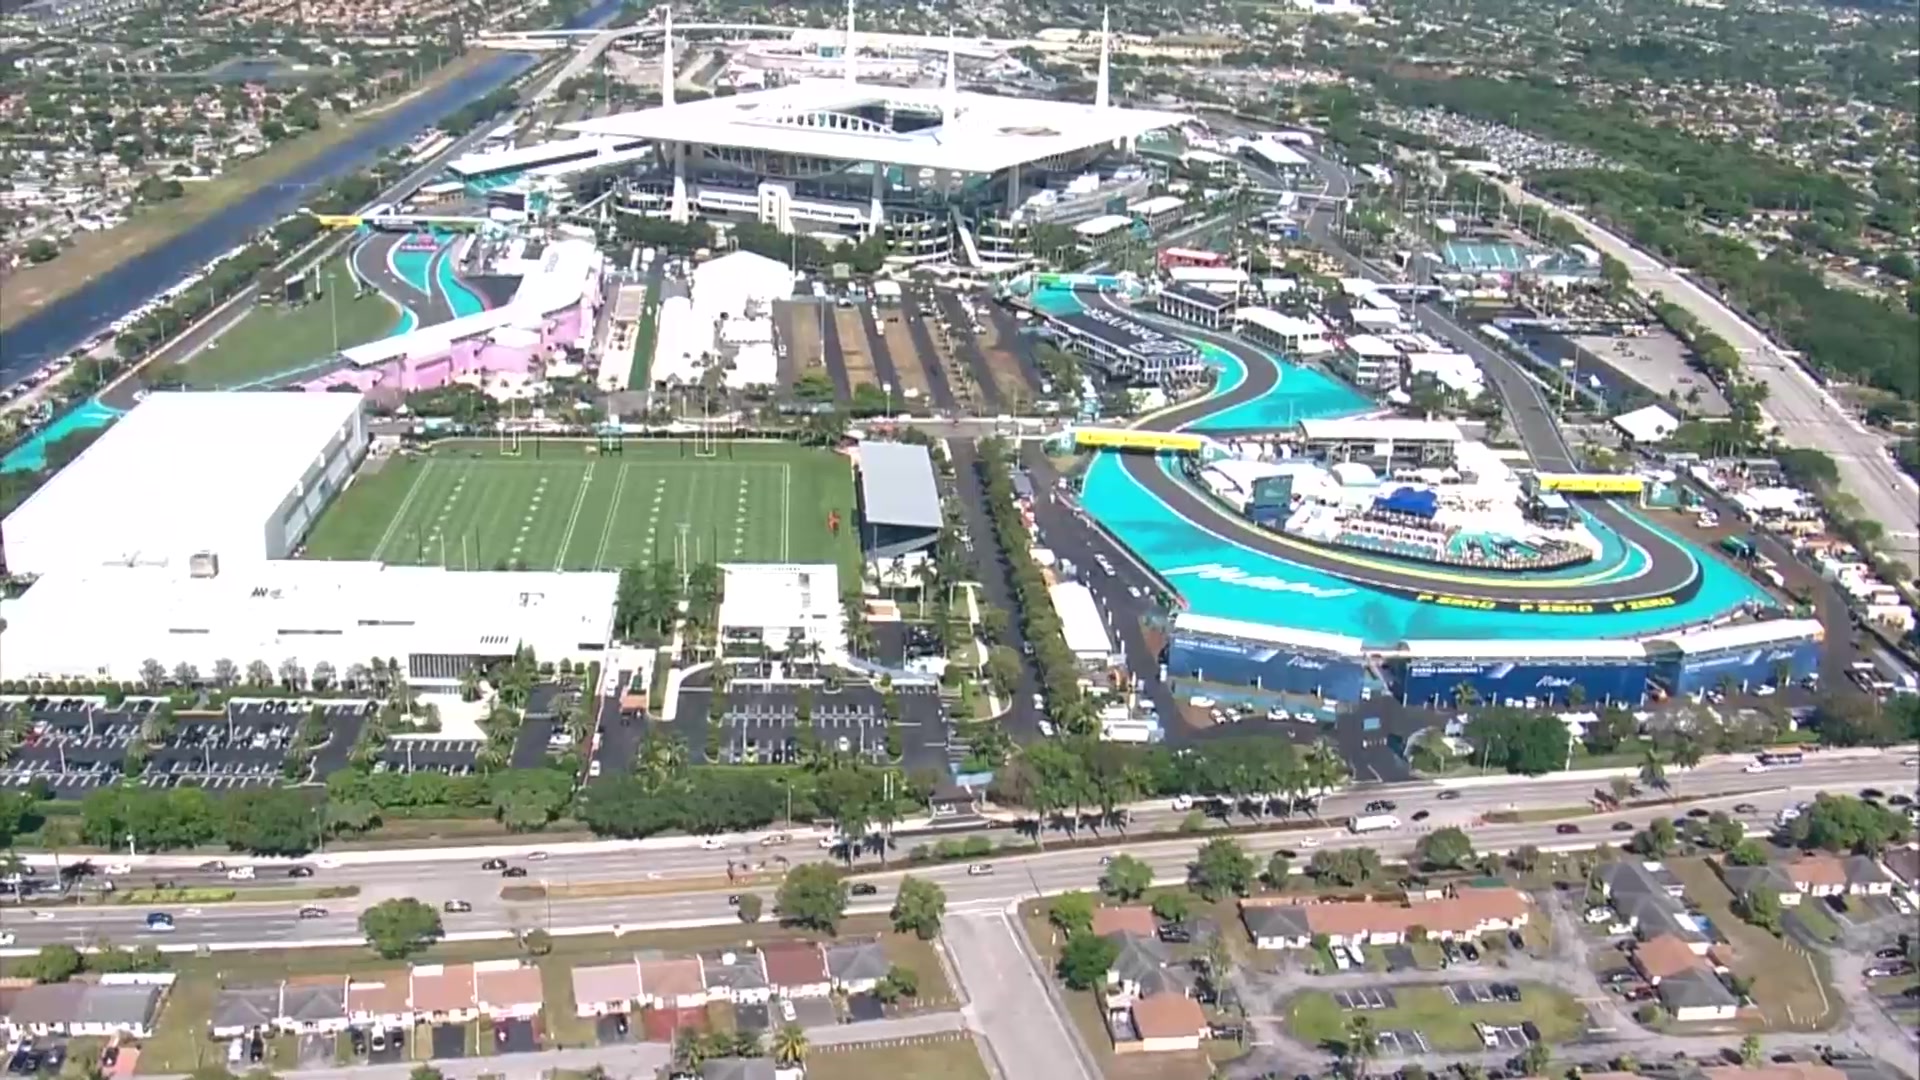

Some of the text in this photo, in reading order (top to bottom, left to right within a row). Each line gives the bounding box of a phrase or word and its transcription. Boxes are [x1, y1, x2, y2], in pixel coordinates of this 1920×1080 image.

[1417, 594, 1497, 609] P ZERO
[1520, 603, 1593, 613] P ZERO
[1612, 596, 1676, 612] P ZERO
